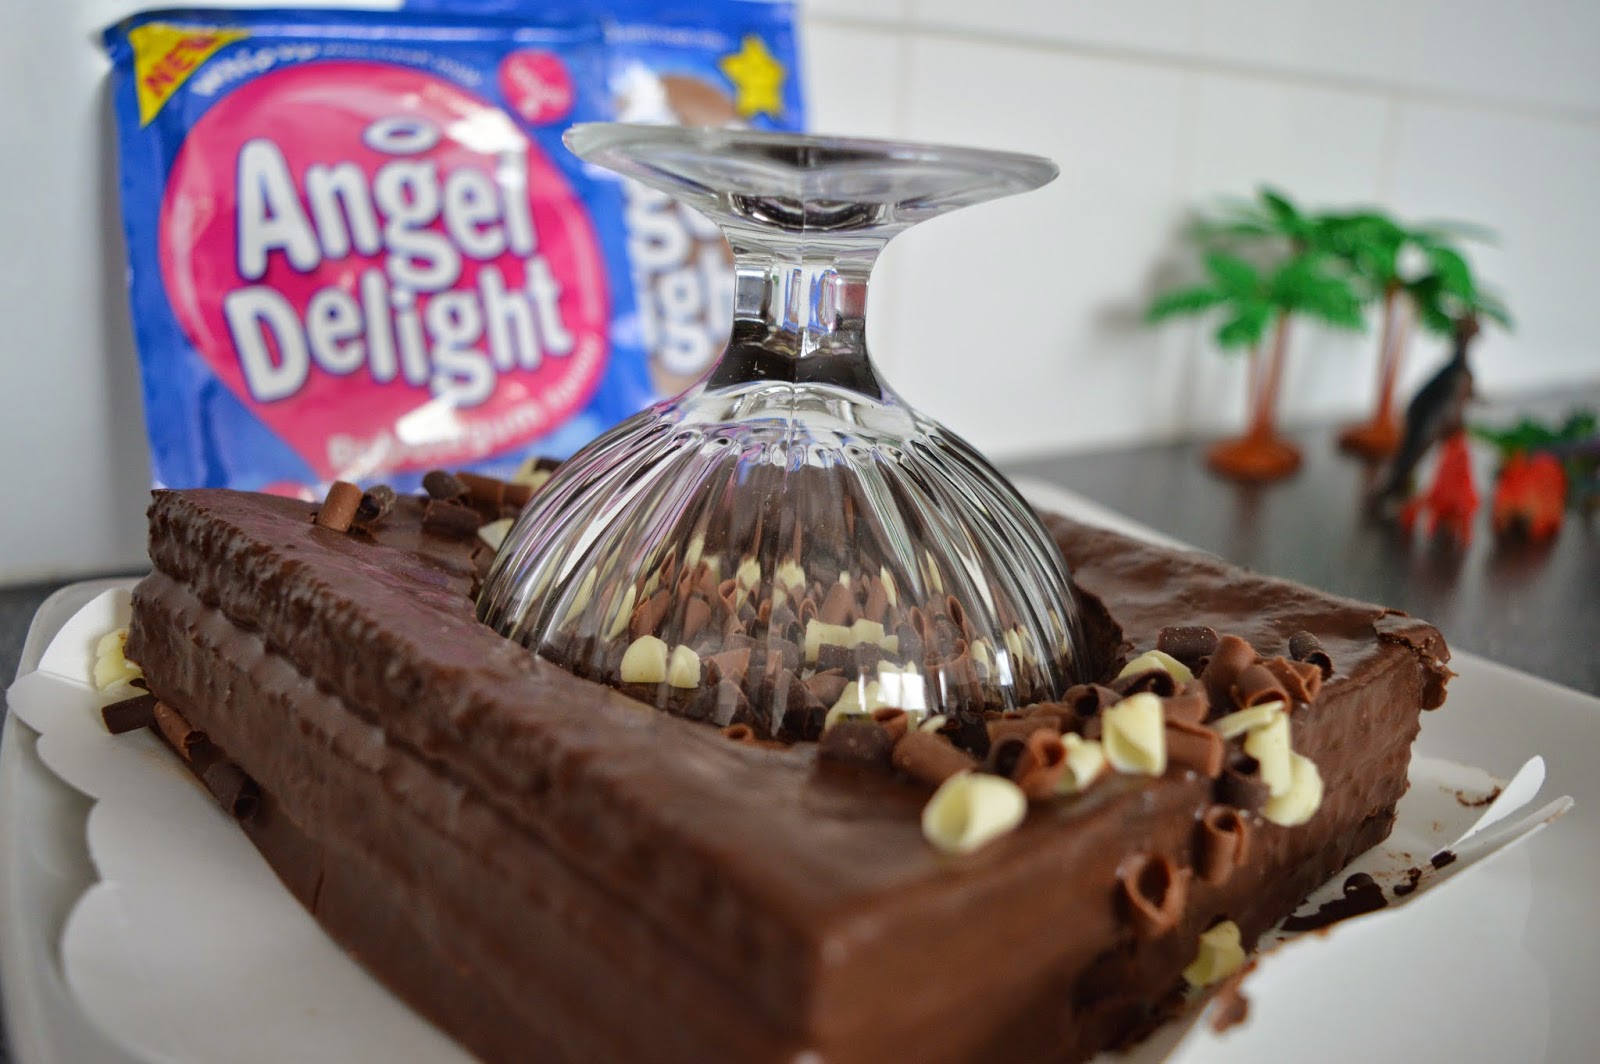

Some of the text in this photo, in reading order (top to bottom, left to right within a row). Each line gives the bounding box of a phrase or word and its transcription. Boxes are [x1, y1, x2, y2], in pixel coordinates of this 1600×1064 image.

[145, 34, 219, 98] NEW
[237, 136, 537, 293] Angel
[223, 255, 575, 407] Delight
